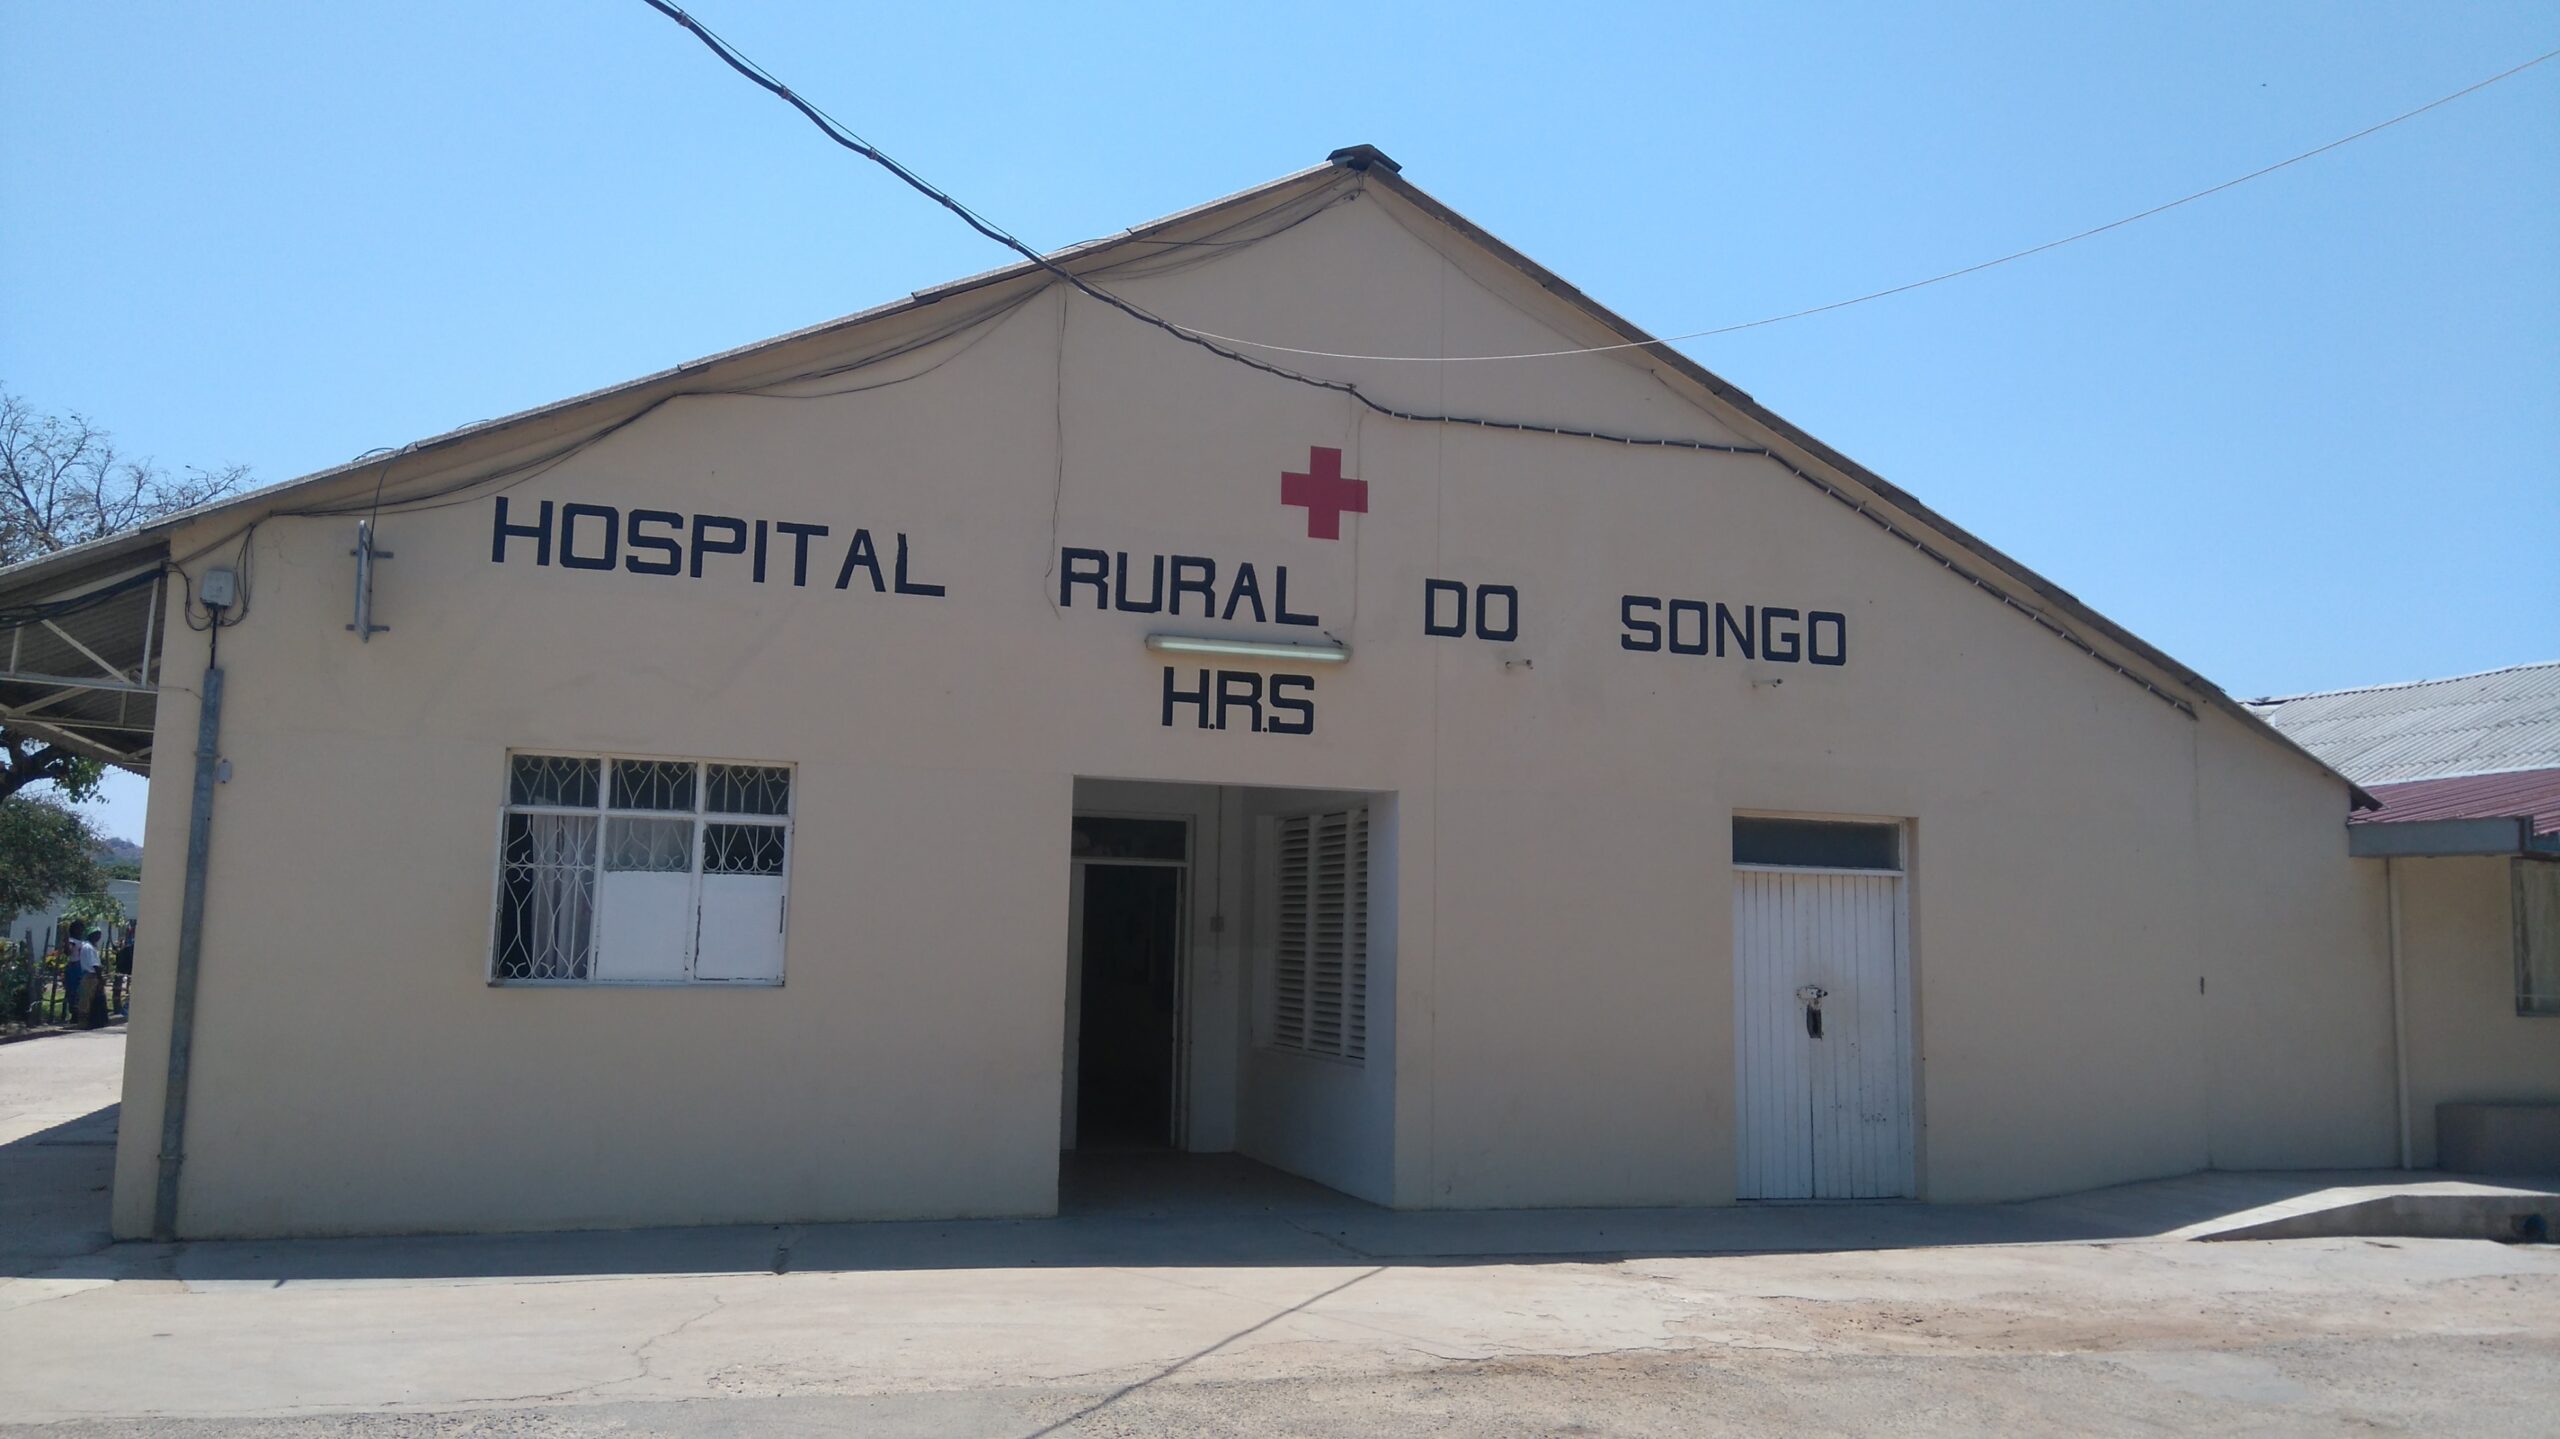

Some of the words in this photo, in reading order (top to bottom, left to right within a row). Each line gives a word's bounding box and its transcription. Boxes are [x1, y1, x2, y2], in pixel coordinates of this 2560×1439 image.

[491, 495, 946, 598] HOSPITAL
[1059, 546, 1320, 627] RURAL
[1424, 577, 1519, 643] DO
[1620, 594, 1847, 667] SONGO
[1161, 665, 1316, 736] H.R.S
